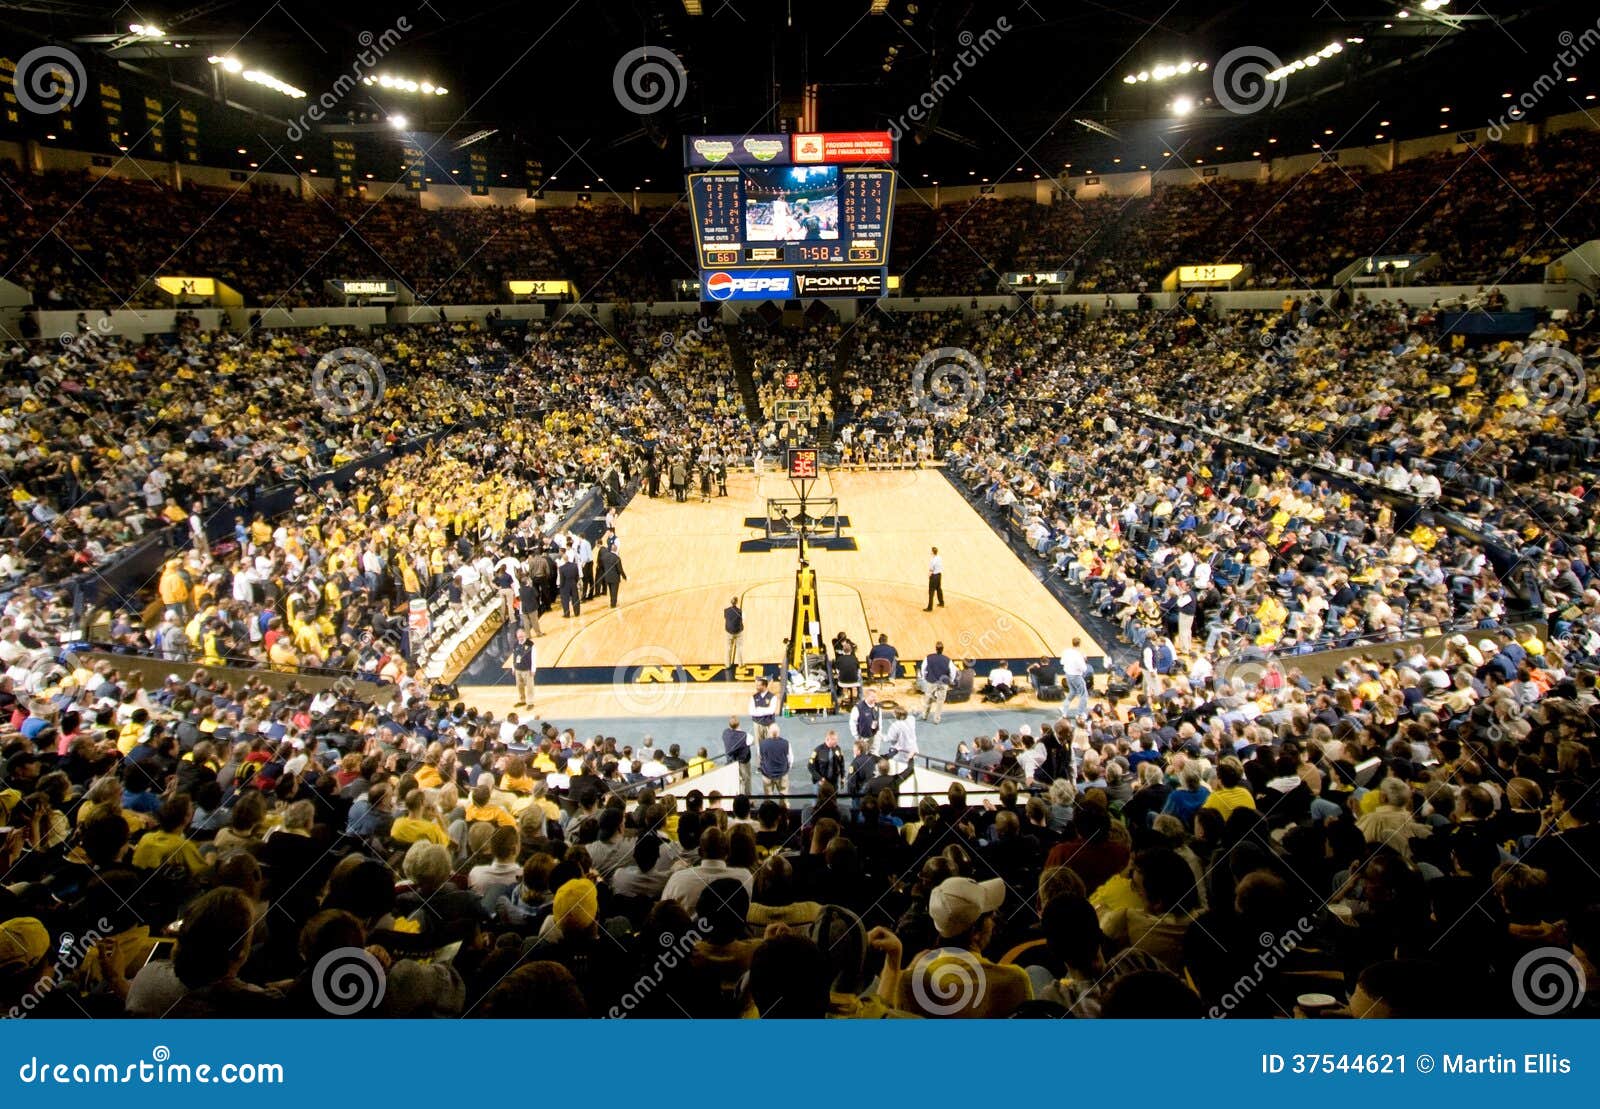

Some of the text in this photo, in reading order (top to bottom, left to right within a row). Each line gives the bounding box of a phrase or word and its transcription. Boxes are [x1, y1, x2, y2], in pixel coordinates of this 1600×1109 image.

[717, 253, 730, 262] 66
[800, 247, 829, 260] 7:58
[858, 250, 871, 259] 55
[731, 277, 789, 292] PEPSI
[805, 276, 880, 287] PONTIAC
[343, 282, 387, 294] MICHIGAN
[533, 282, 546, 292] M
[796, 452, 815, 461] 7:58
